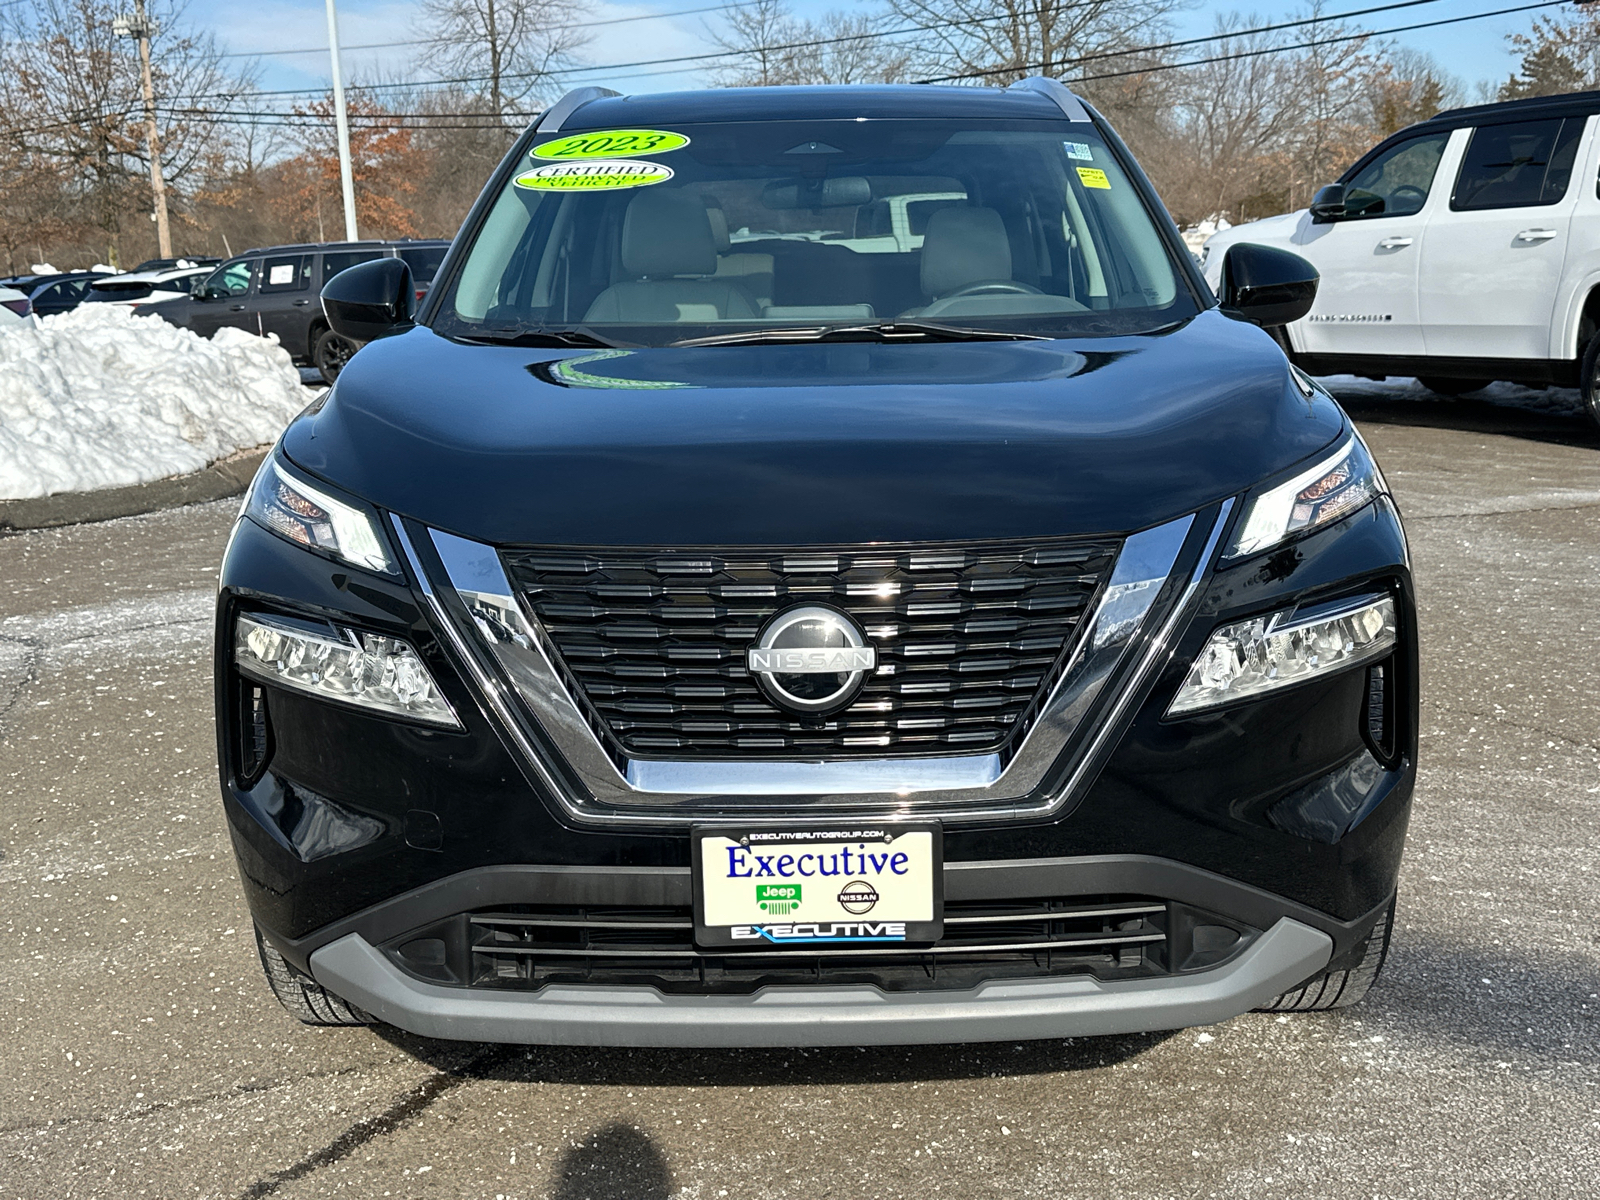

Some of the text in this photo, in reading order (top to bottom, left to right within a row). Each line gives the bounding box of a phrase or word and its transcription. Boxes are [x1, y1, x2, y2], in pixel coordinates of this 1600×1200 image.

[553, 135, 666, 156] 2023
[536, 166, 658, 177] CERTIFIED
[753, 651, 870, 668] NISSAN
[749, 830, 885, 841] EXECUTIVEAUTOGROUP.COM
[726, 844, 909, 878] Executive
[762, 886, 796, 899] Jeep
[731, 922, 906, 940] EXECUTIVE
